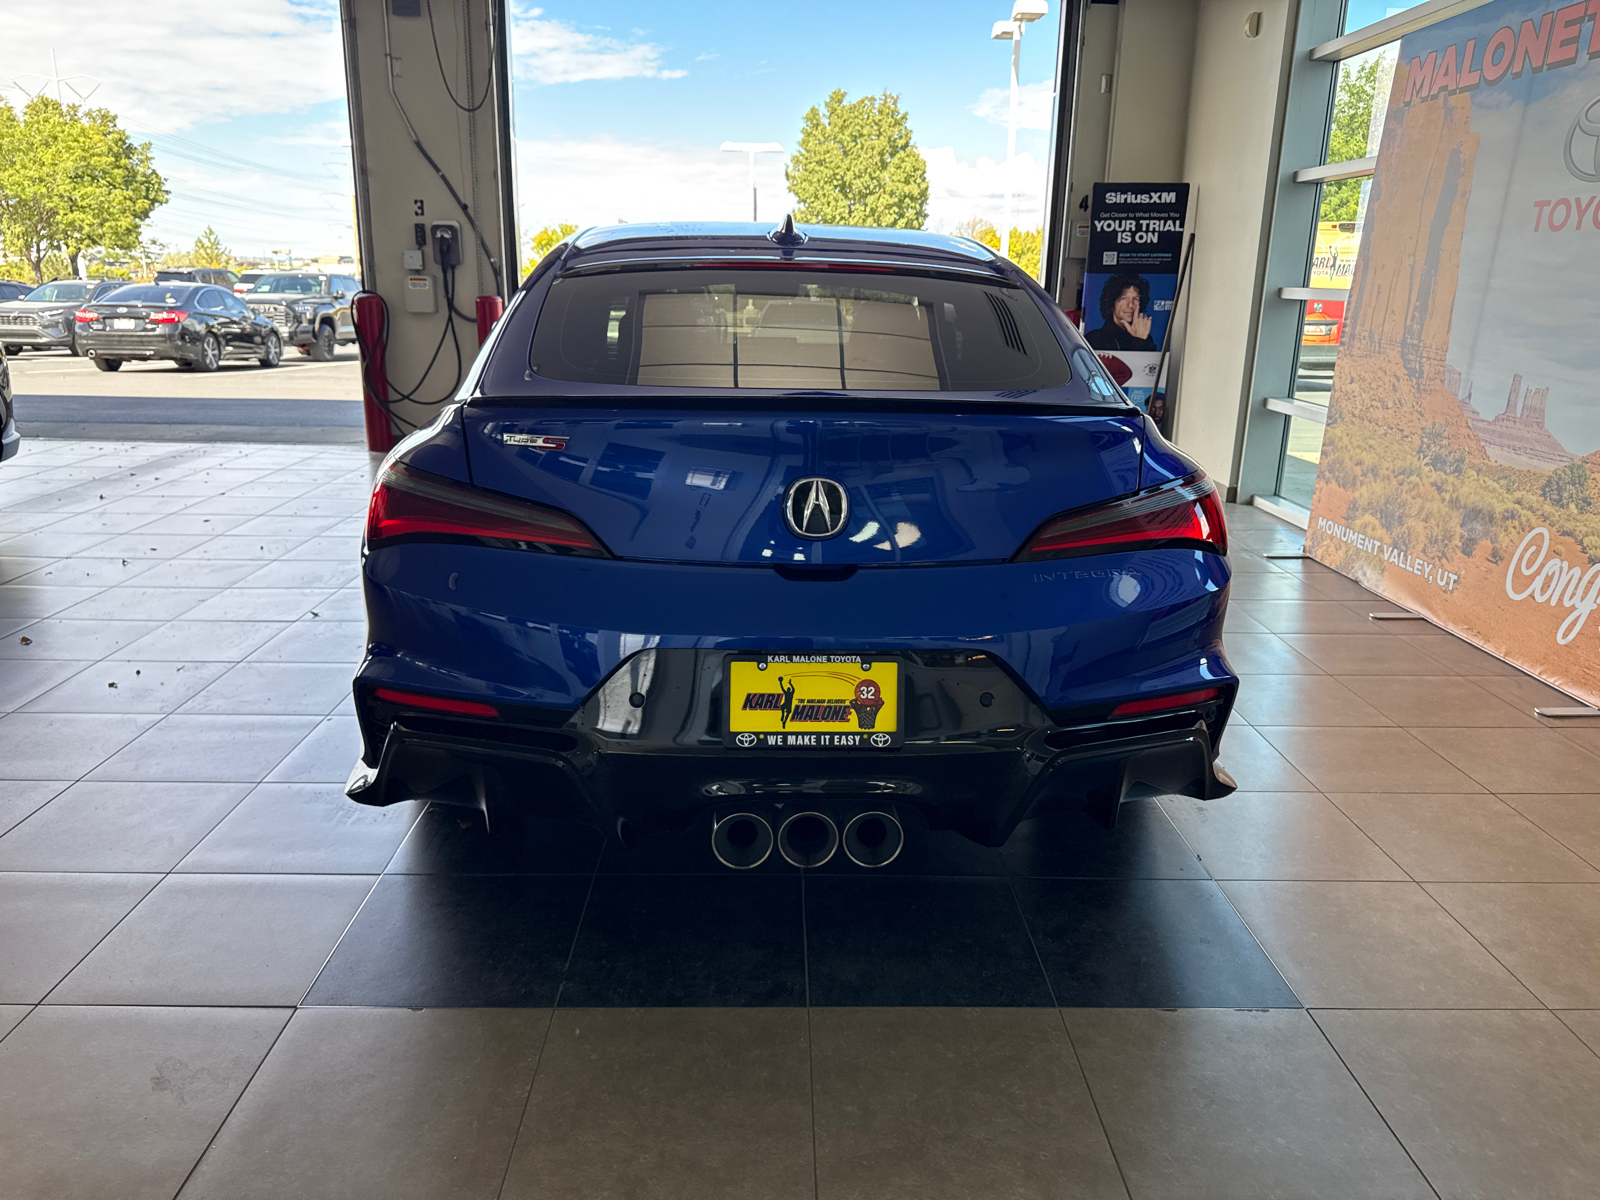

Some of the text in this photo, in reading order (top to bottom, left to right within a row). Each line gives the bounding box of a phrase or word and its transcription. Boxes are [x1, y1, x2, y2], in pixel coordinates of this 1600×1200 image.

[1079, 195, 1089, 212] 4
[1105, 192, 1176, 204] SiriusXM
[414, 199, 425, 216] 3
[1094, 220, 1136, 232] YOUR
[1139, 220, 1184, 232] TRIAL
[1117, 232, 1159, 243] IS ON
[1313, 257, 1330, 268] ARL
[1317, 517, 1458, 590] MONUMENT VALLEY, UT
[1033, 567, 1141, 582] INTEGRA
[1505, 527, 1600, 645] Cong
[767, 655, 862, 663] KARL MALONE TOYOTA
[859, 686, 875, 699] 32
[741, 693, 784, 710] KARL
[789, 705, 852, 722] MALONE
[767, 735, 861, 746] WE MAKE IT EASY
